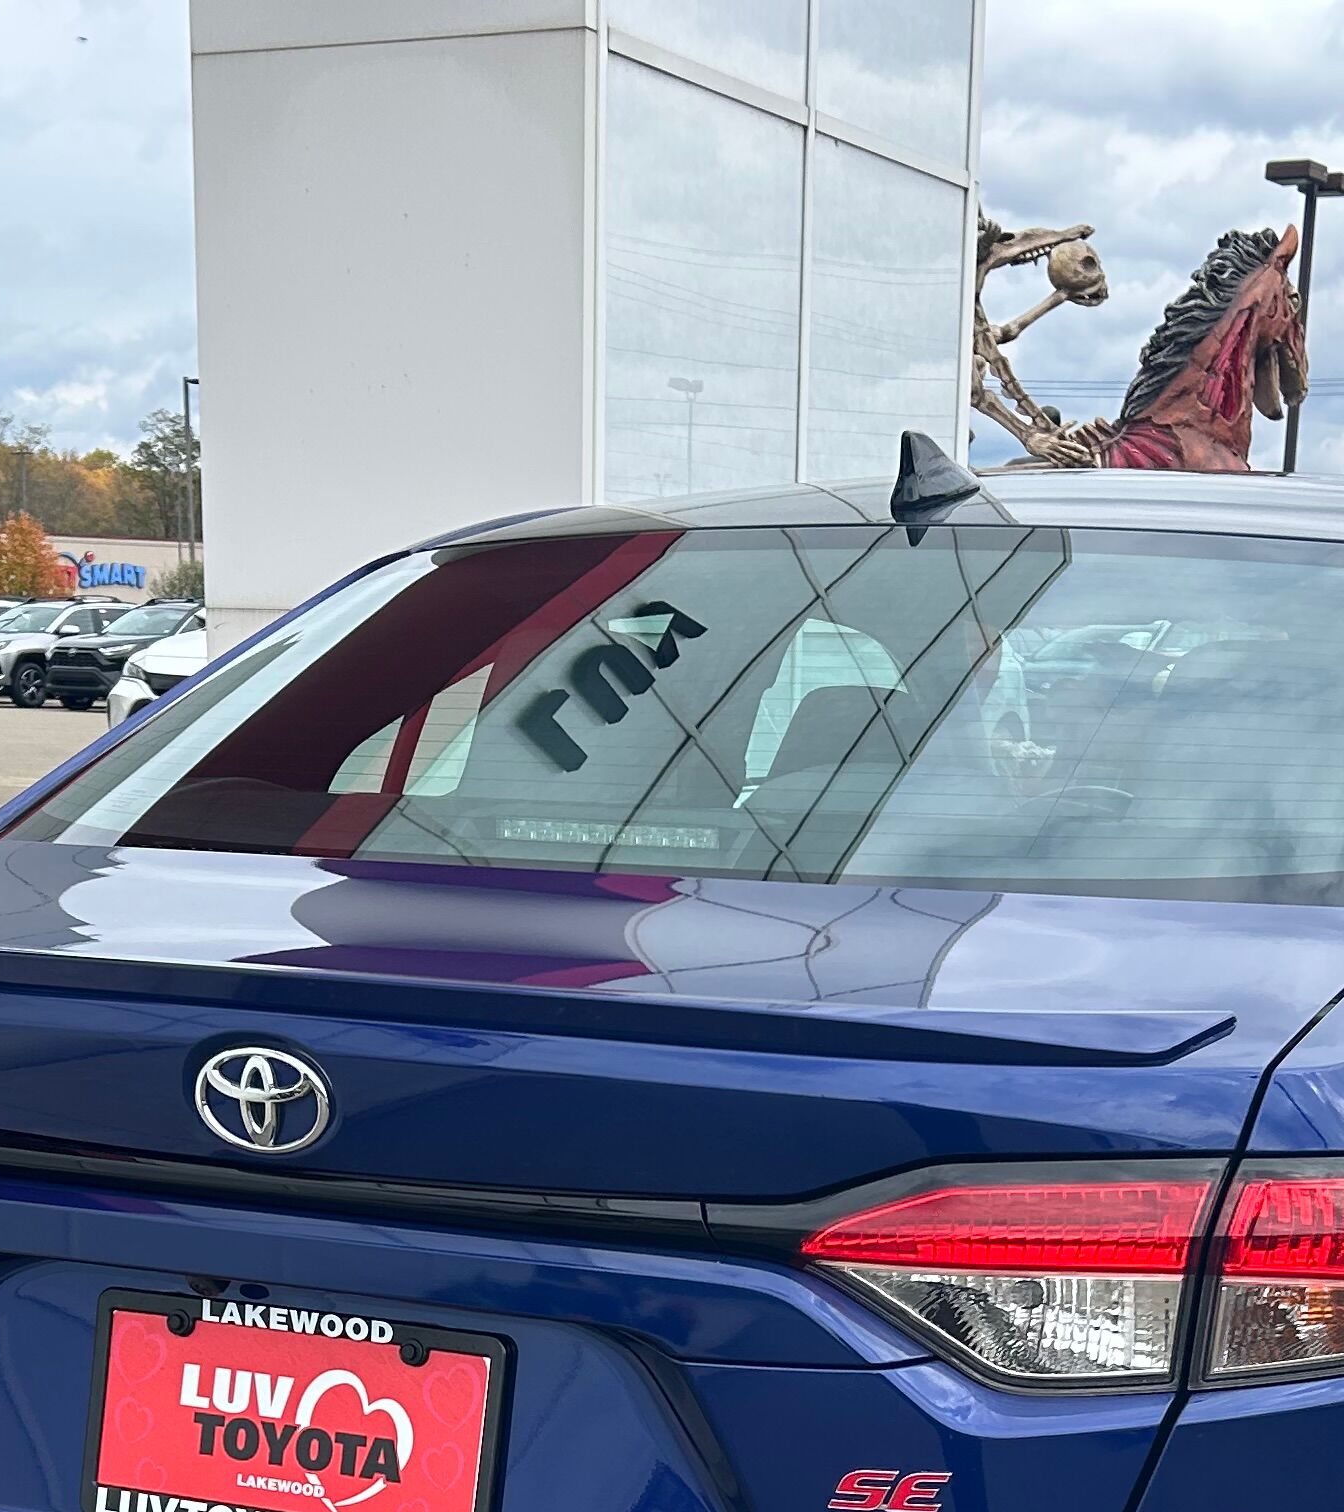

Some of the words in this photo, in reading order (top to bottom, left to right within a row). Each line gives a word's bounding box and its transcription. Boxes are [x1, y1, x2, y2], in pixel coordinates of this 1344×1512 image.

[201, 1298, 394, 1344] LAKEWOOD
[179, 1363, 295, 1418] LUV
[193, 1412, 403, 1484] TOYOTA
[236, 1473, 326, 1499] LAKEWOOD
